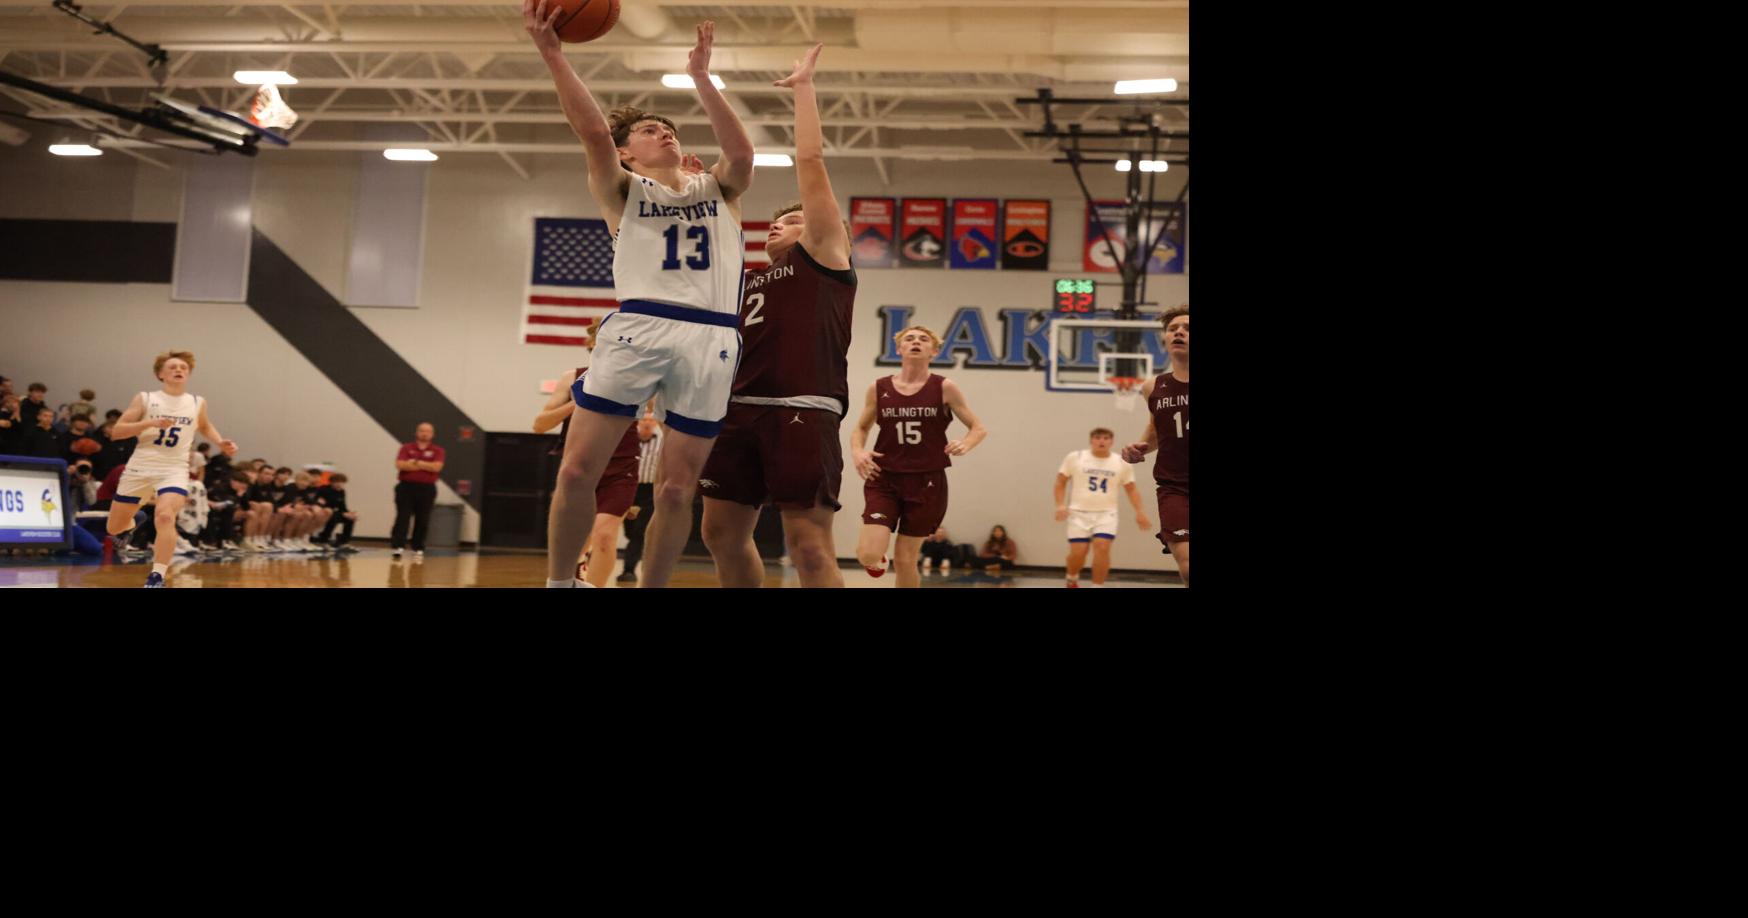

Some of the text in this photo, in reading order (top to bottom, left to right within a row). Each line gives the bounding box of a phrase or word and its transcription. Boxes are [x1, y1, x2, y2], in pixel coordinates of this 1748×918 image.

[662, 224, 711, 271] 13
[745, 292, 765, 326] 2
[1059, 293, 1093, 312] 32
[881, 407, 938, 418] ARLINGTON
[1157, 395, 1189, 410] ARLIN
[895, 421, 922, 445] 15
[1173, 411, 1189, 438] 1
[153, 427, 182, 447] 15
[1088, 476, 1108, 493] 54
